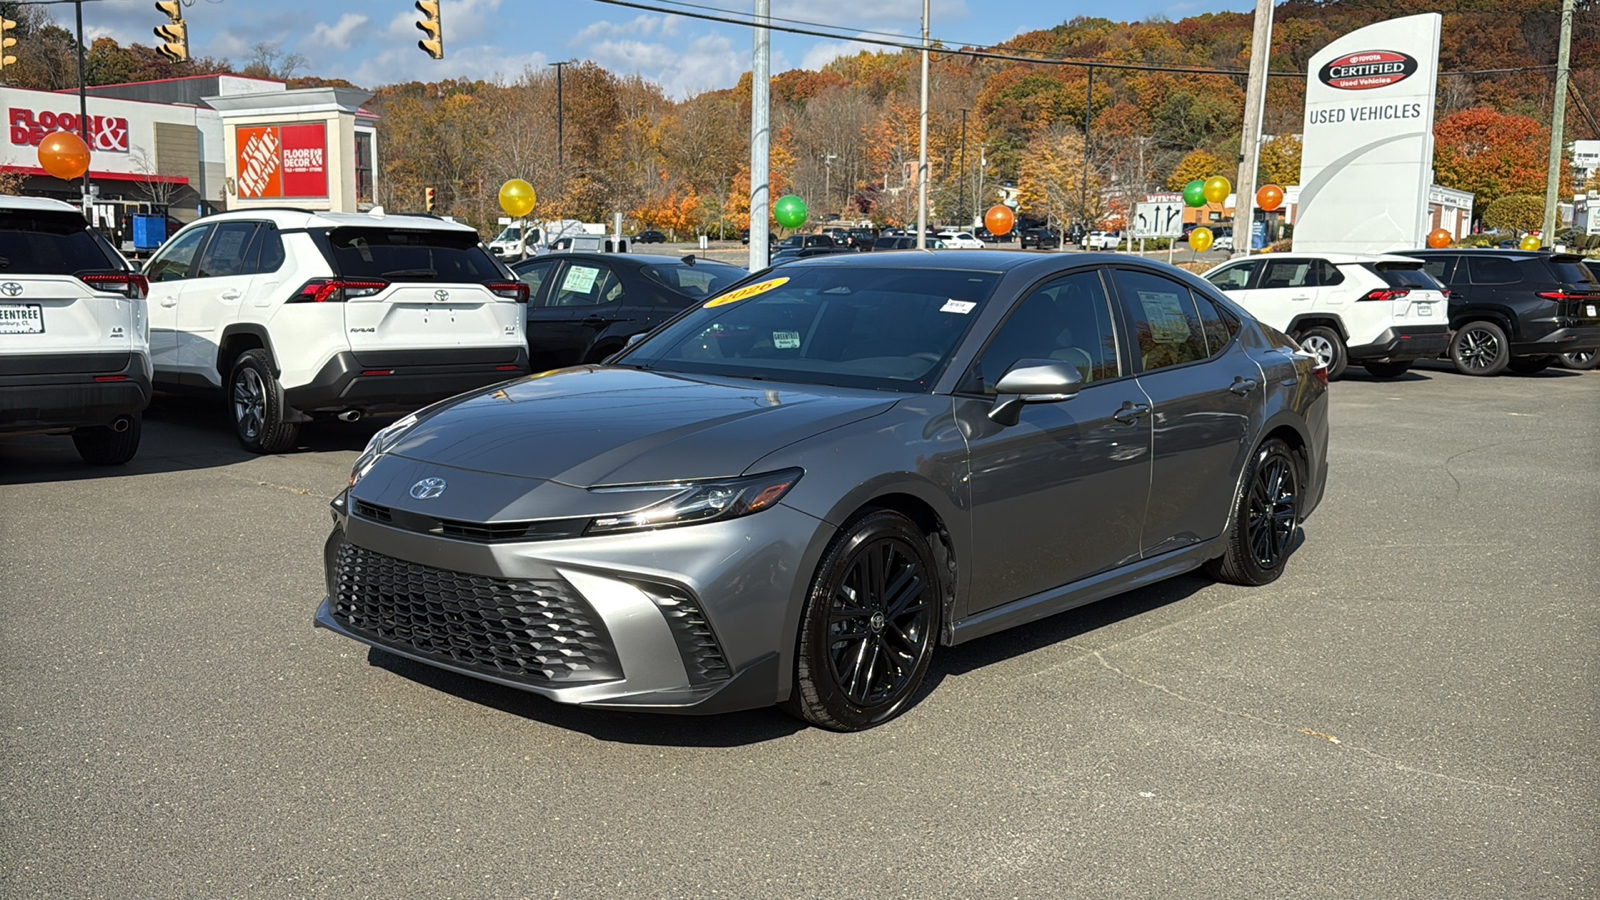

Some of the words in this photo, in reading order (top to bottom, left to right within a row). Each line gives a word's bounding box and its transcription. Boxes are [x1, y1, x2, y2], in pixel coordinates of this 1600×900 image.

[1358, 54, 1381, 62] TOYOTA
[1329, 62, 1405, 78] CERTIFIED
[1359, 77, 1391, 85] Vehicles
[9, 108, 95, 132] FLOOR
[1310, 109, 1346, 124] USED
[1350, 103, 1421, 121] VEHICLES
[241, 132, 260, 163] THE
[283, 149, 310, 159] FLOOR
[239, 127, 279, 197] HOME
[284, 158, 310, 168] DECOR
[253, 151, 280, 197] DEPOT
